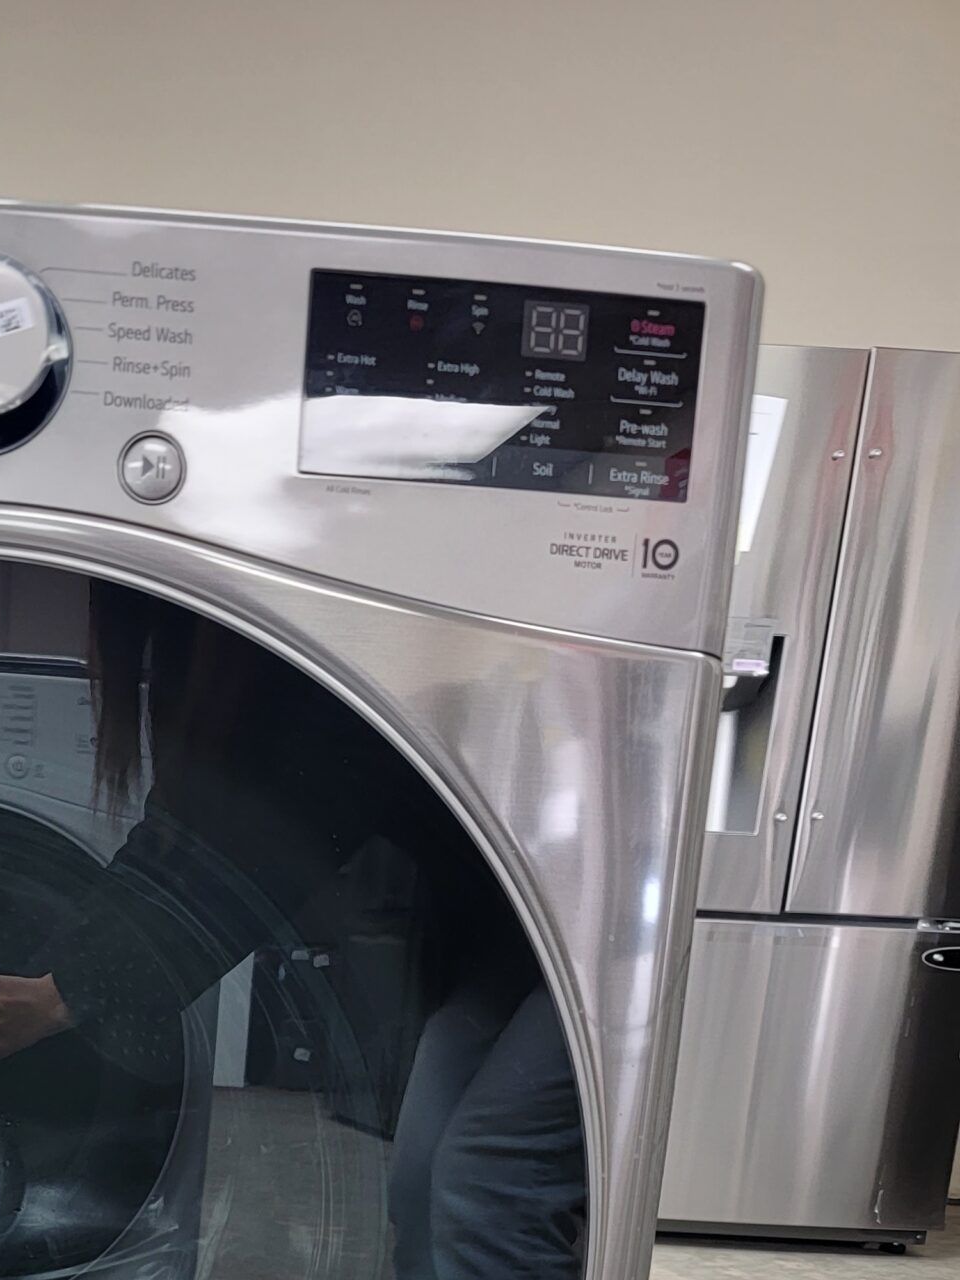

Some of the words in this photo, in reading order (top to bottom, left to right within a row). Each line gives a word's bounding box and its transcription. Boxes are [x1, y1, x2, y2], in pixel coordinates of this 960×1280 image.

[131, 260, 197, 282] Delicates
[111, 290, 152, 310] Perm.
[155, 294, 195, 313] Press
[344, 294, 367, 306] Wash
[406, 299, 429, 312] Rinse
[470, 304, 489, 318] Spin
[107, 321, 151, 344] Speed
[155, 326, 194, 345] Wash
[640, 320, 676, 337] Steam
[112, 355, 191, 380] Rinse+Spin
[336, 352, 359, 365] Extra
[360, 355, 377, 367] Hot
[437, 360, 460, 374] Extra
[460, 363, 481, 377] High
[617, 366, 649, 387] Delay
[649, 370, 680, 387] Wash
[533, 384, 553, 397] Cold
[553, 386, 576, 400] Wash
[619, 419, 669, 437] Pre-wash
[529, 432, 552, 447] Light
[531, 461, 554, 477] Soil
[609, 467, 638, 483] Extra
[640, 469, 670, 486] Rinse
[563, 531, 617, 544] INVERTER
[549, 543, 592, 559] DIRECT
[593, 546, 629, 562] DRIVE
[642, 537, 680, 571] 10
[573, 559, 603, 570] MOTOR
